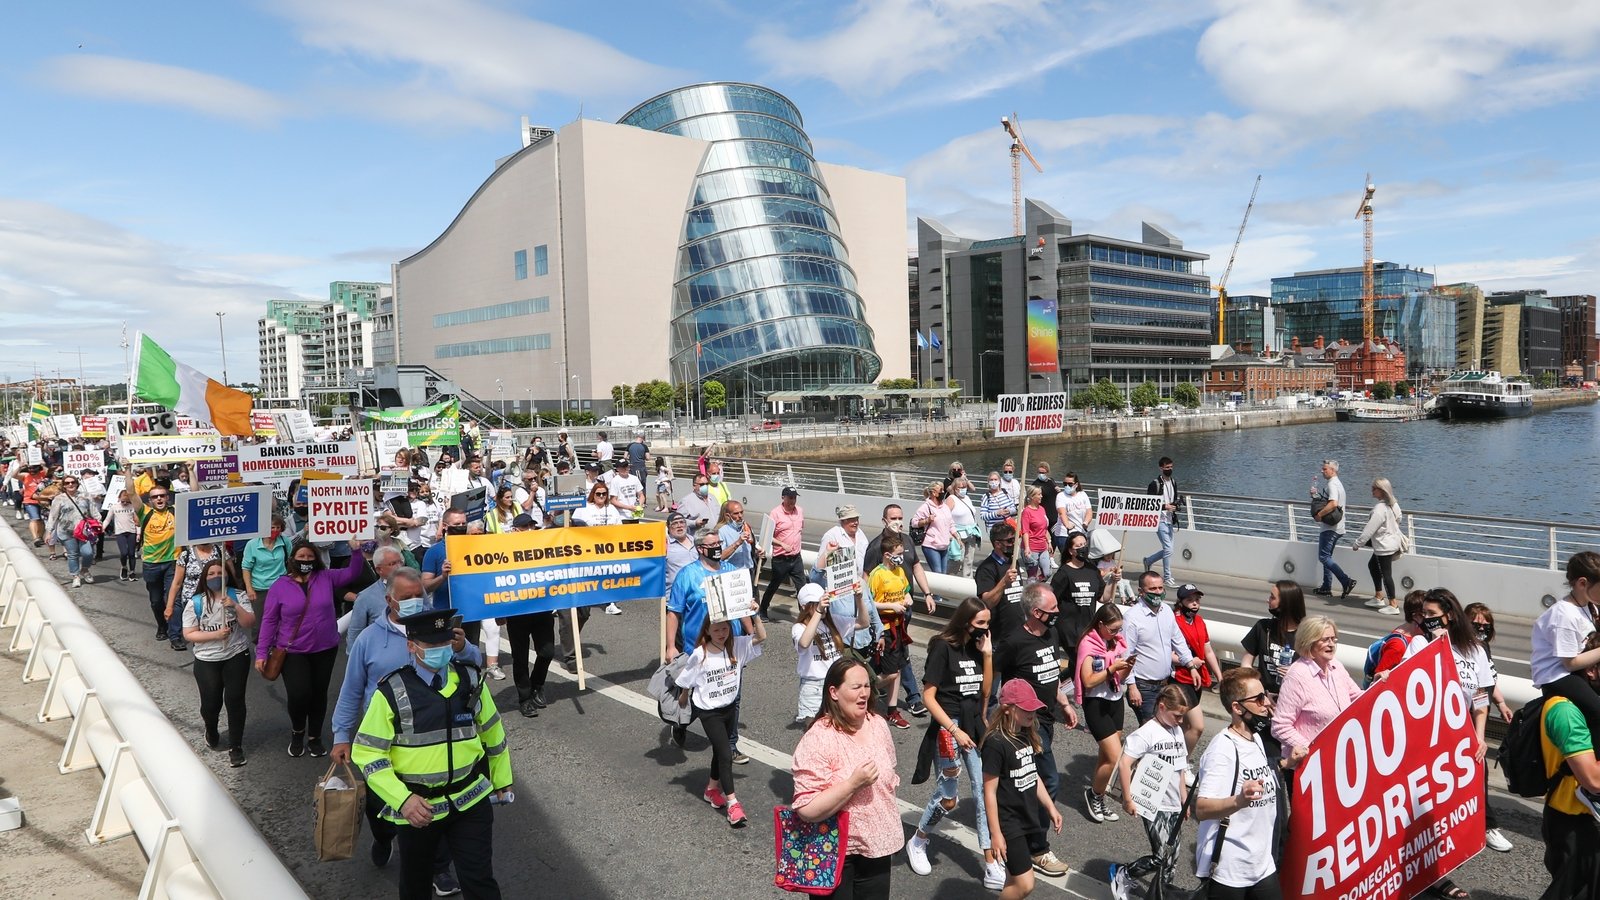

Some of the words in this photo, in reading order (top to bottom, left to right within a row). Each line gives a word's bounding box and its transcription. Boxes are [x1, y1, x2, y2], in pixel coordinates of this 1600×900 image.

[1031, 246, 1043, 255] pwc
[1031, 326, 1054, 338] Shine
[1000, 396, 1024, 412] 100%
[1026, 394, 1064, 412] REDRESS
[998, 416, 1022, 432] 100%
[1024, 414, 1062, 430] REDRESS
[68, 453, 100, 462] 100%
[129, 444, 216, 457] paddydiver79
[260, 446, 295, 457] BANKS
[306, 444, 339, 454] BAILED
[242, 457, 316, 471] HOMEOWNERS
[327, 455, 356, 466] FAILED
[311, 486, 342, 496] NORTH
[345, 486, 370, 496] MAYO
[197, 494, 250, 507] DEFECTIVE
[313, 501, 368, 516] PYRITE
[1101, 496, 1124, 510] 100%
[1125, 497, 1161, 511] REDRESS
[203, 505, 244, 516] BLOCKS
[200, 515, 247, 527] DESTROY
[314, 519, 368, 535] GROUP
[1098, 512, 1120, 526] 100%
[1122, 514, 1159, 527] REDRESS
[210, 526, 237, 536] LIVES
[464, 552, 509, 566] 100%
[513, 544, 582, 562] REDRESS
[594, 543, 614, 554] NO
[619, 540, 654, 552] LESS
[495, 575, 516, 588] NO
[520, 563, 630, 584] DISCRIMINATION
[484, 587, 546, 604] INCLUDE
[549, 580, 599, 596] COUNTY
[602, 576, 641, 590] CLARE
[1300, 653, 1467, 840] 100%
[1145, 767, 1163, 783] family
[1140, 776, 1160, 792] homes
[457, 785, 484, 806] GARDA
[1301, 738, 1476, 896] REDRESS
[1398, 817, 1448, 864] FAMILES
[1450, 796, 1478, 828] NOW
[1405, 857, 1420, 881] BY
[1424, 836, 1455, 869] MICA
